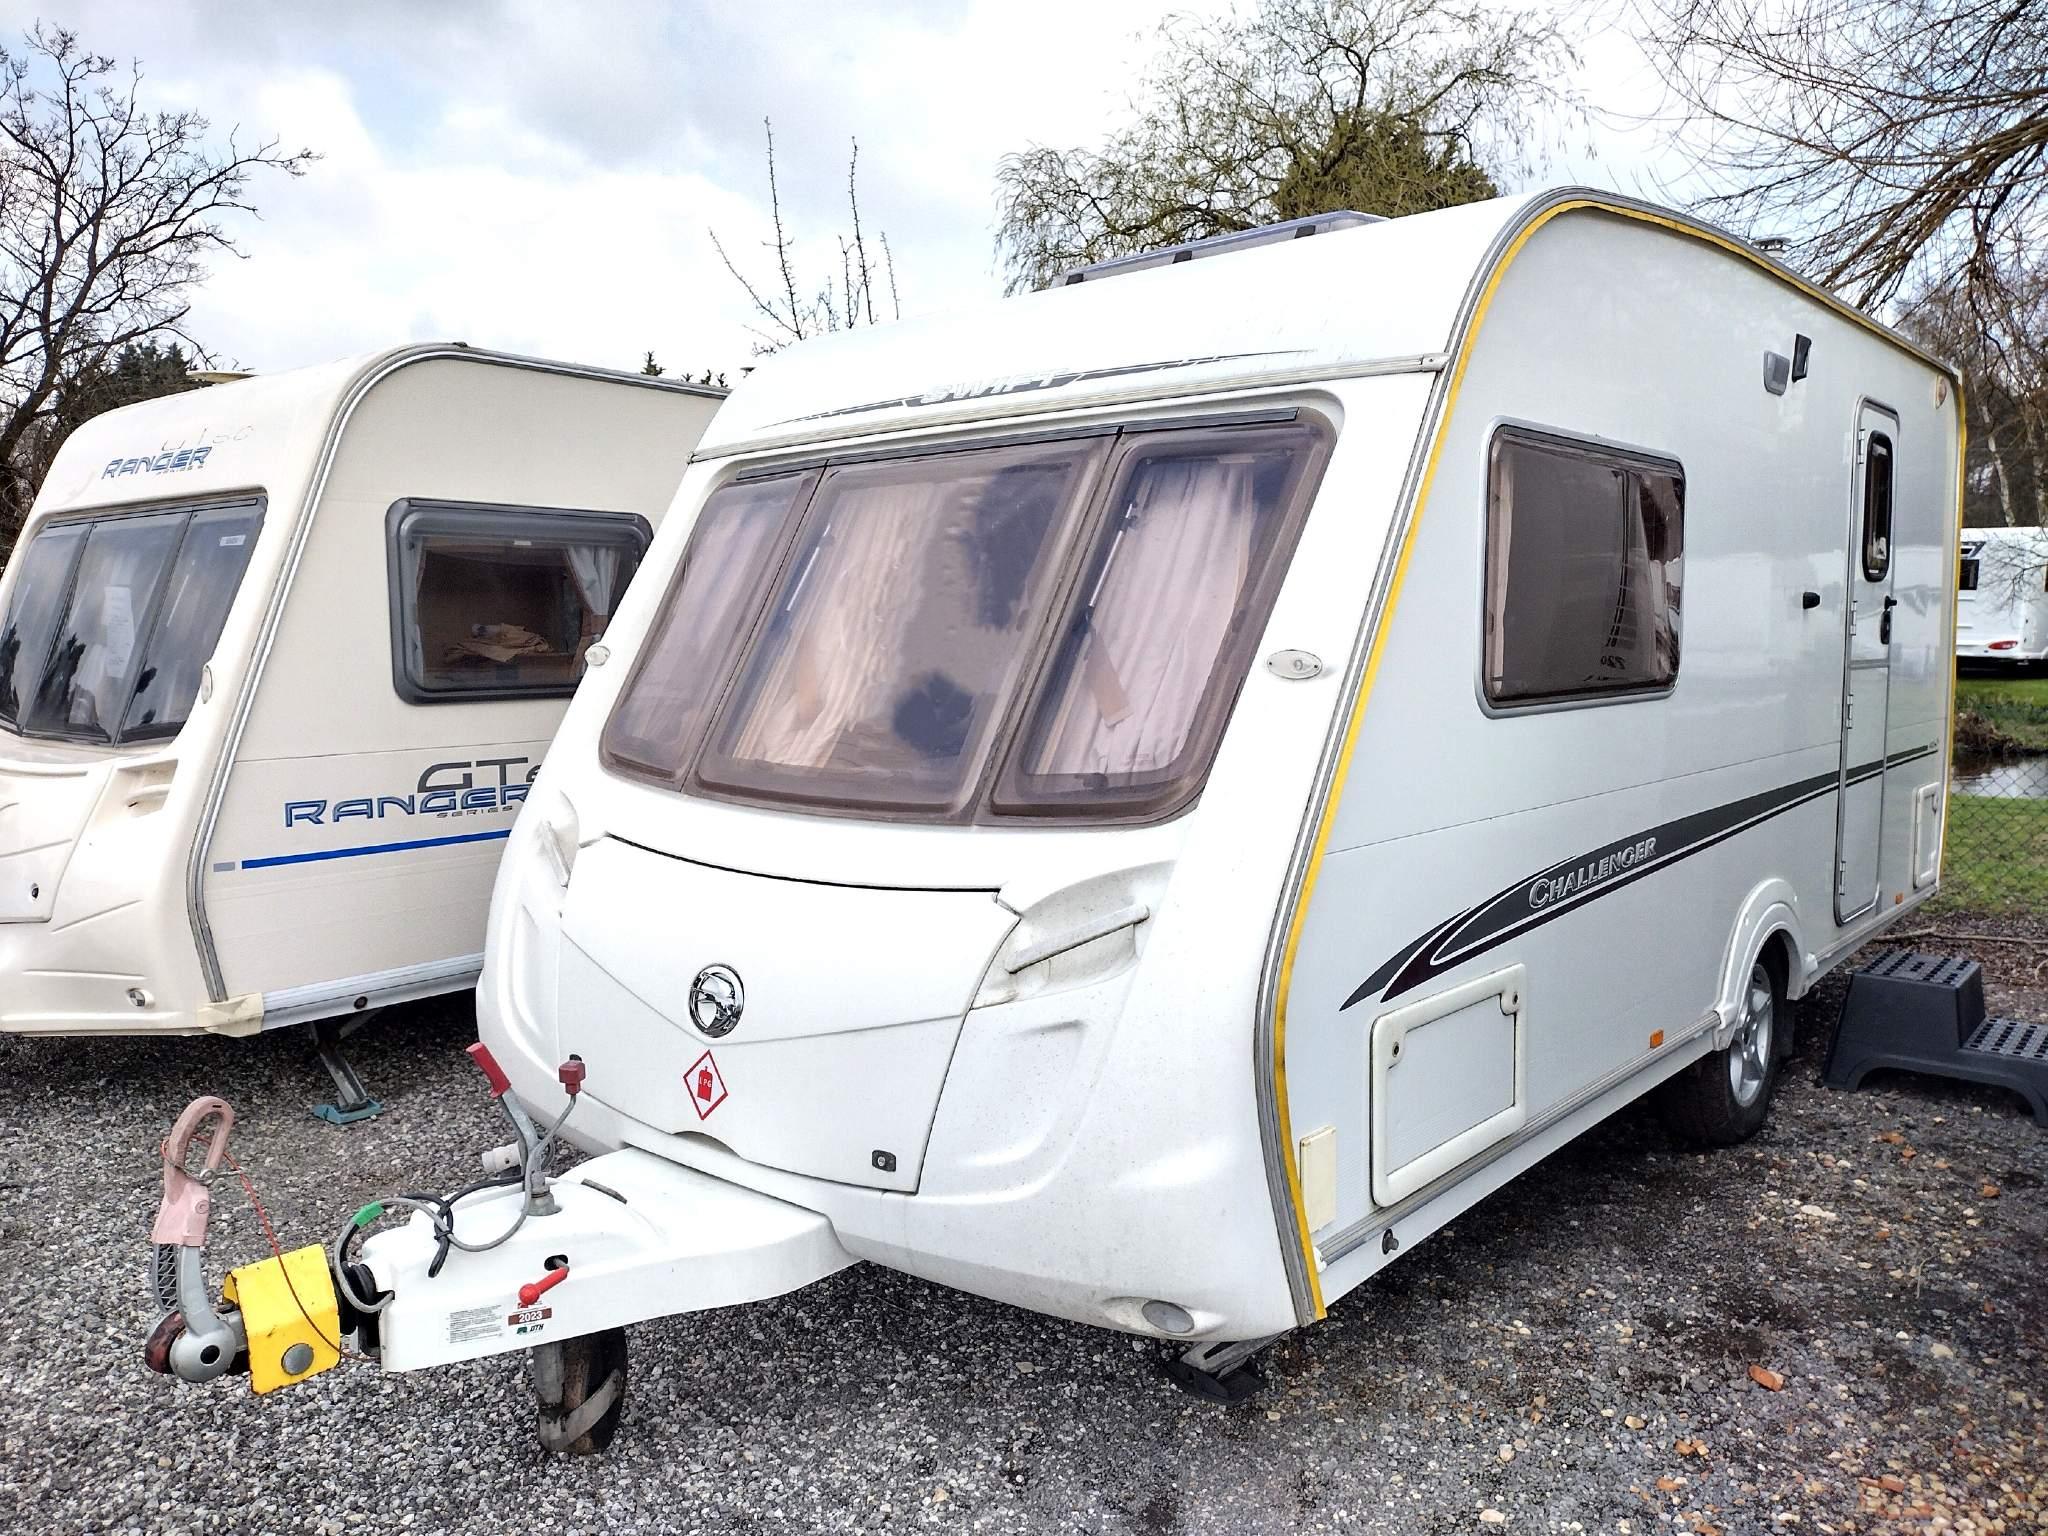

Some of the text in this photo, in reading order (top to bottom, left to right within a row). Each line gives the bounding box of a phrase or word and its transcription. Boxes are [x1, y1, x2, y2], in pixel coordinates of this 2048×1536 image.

[921, 368, 1069, 403] SWIFT
[101, 446, 212, 479] RANGER
[436, 805, 513, 818] SERIES
[1529, 837, 1657, 909] CHALLENGER
[699, 1076, 712, 1088] LPG
[519, 1311, 543, 1323] 2023
